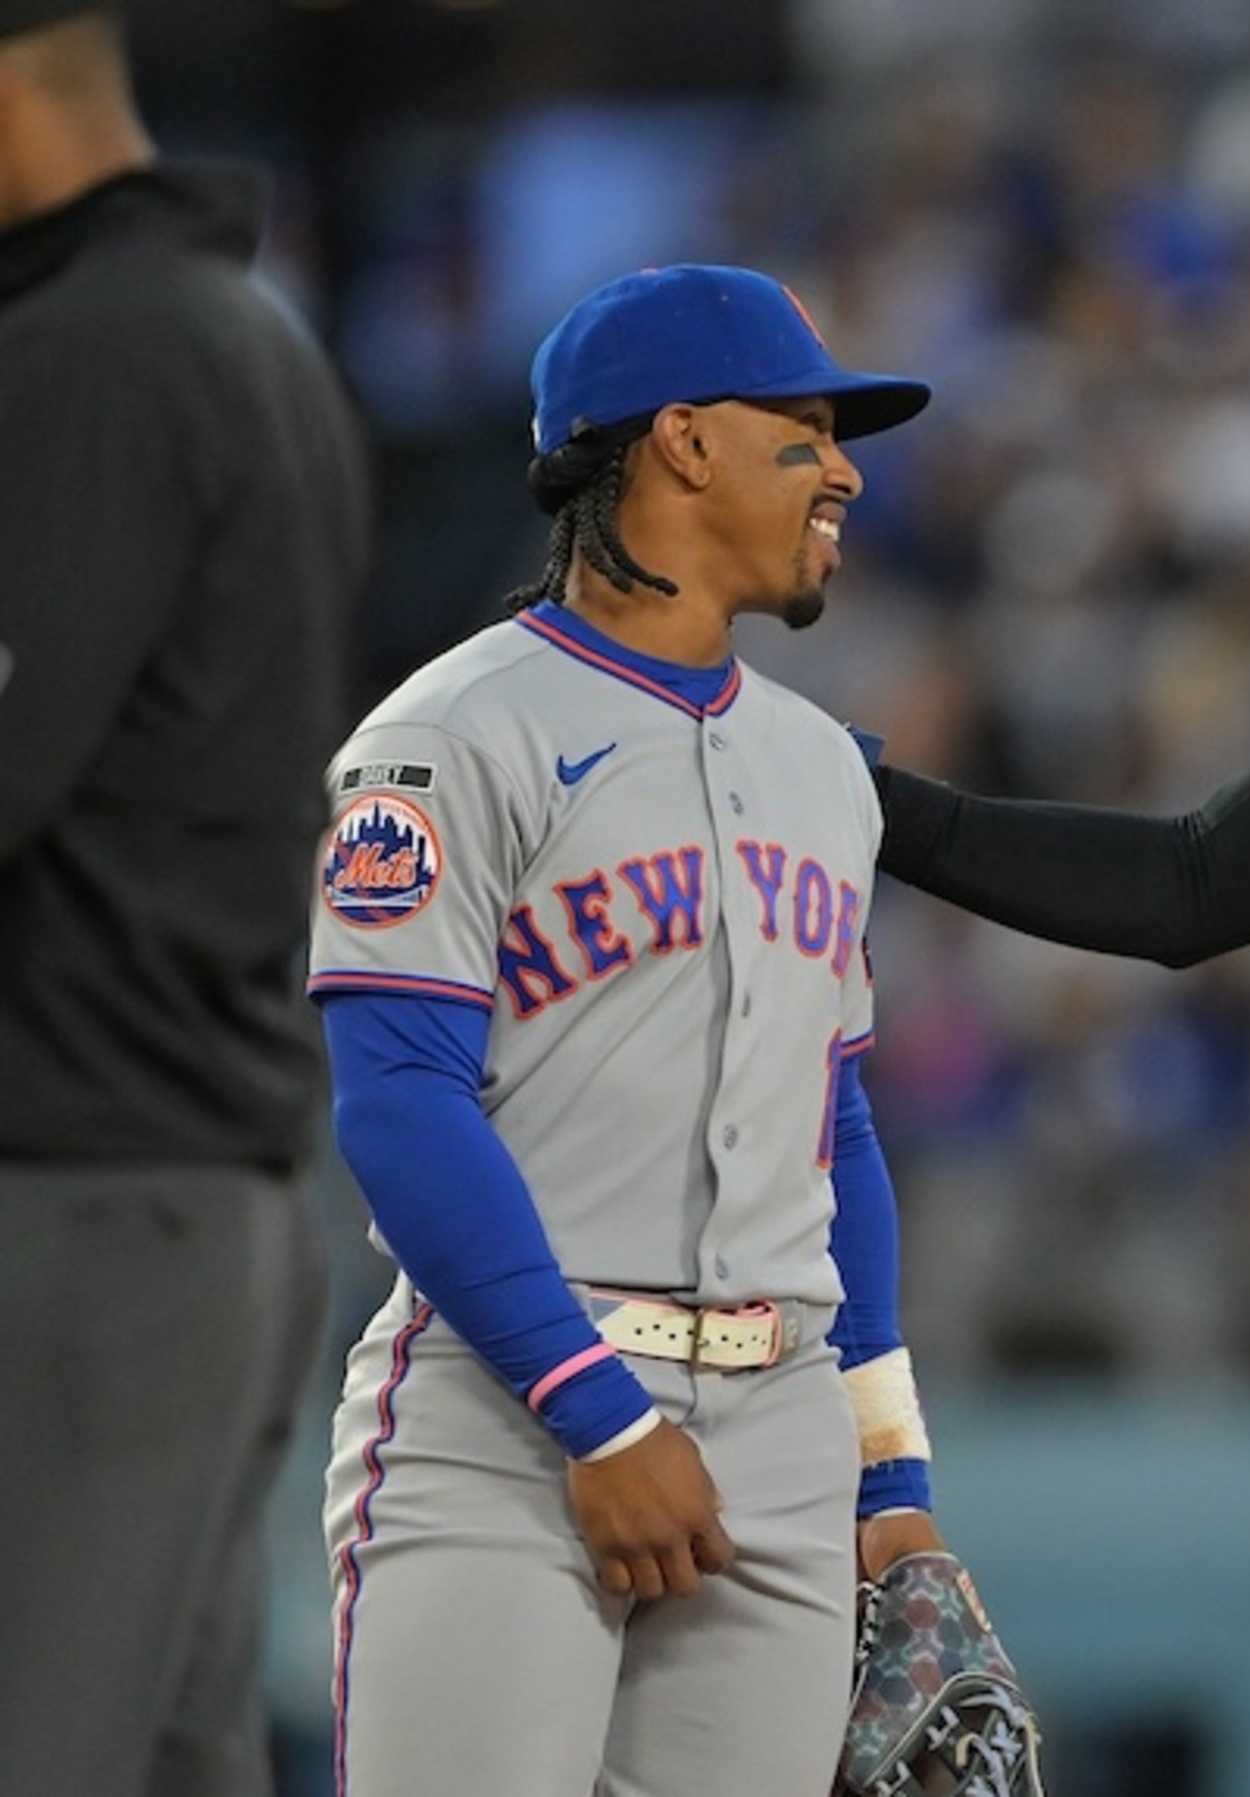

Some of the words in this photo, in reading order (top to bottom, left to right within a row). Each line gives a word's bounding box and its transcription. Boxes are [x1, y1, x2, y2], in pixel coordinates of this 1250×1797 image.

[334, 843, 419, 888] Mets
[498, 845, 706, 1020] NEW
[736, 840, 859, 979] YO
